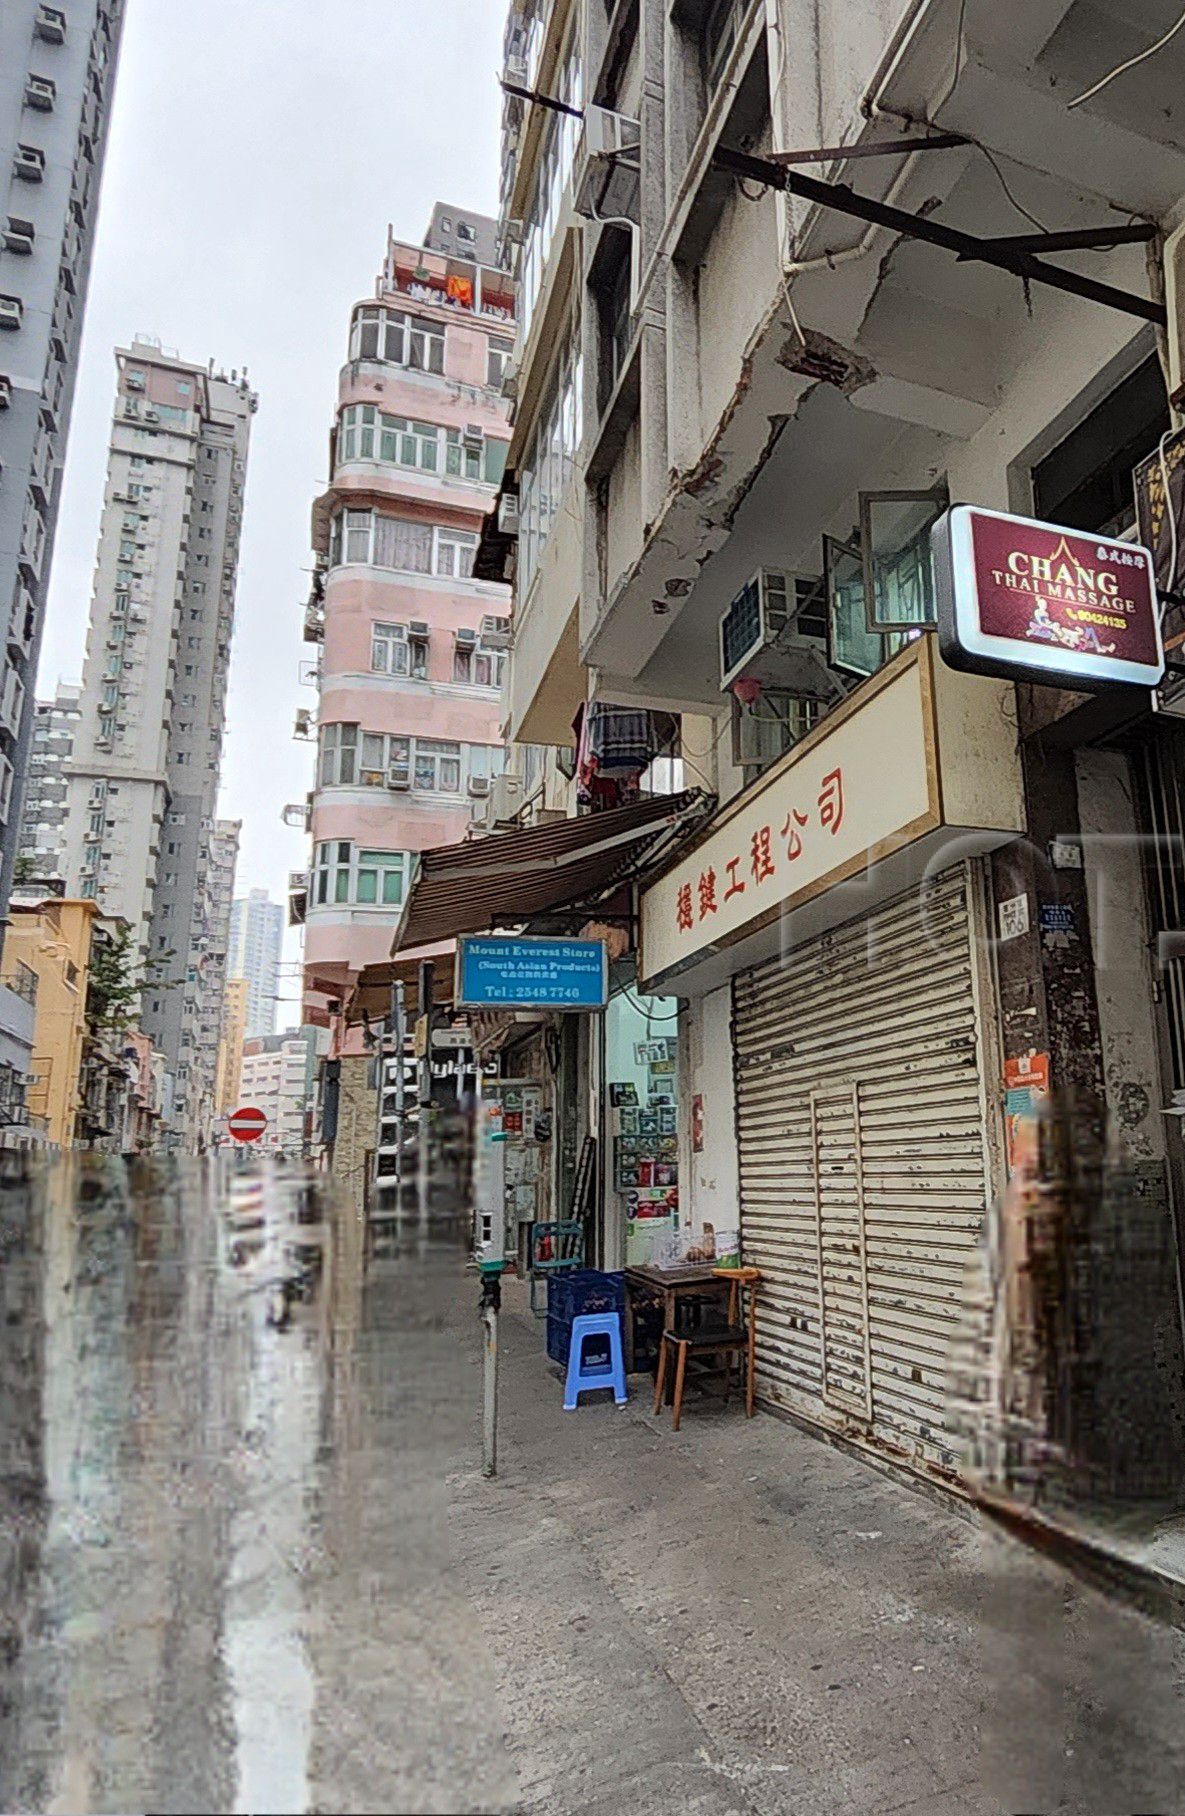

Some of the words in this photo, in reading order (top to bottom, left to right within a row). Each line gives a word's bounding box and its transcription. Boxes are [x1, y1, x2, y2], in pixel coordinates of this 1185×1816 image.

[1007, 551, 1119, 596] CHANG
[992, 570, 1039, 593] THAI
[1047, 582, 1136, 613] MASSAGE
[469, 945, 509, 956] Mount
[513, 946, 560, 956] Everest
[562, 947, 595, 958] Store
[517, 962, 547, 970] Asian
[516, 986, 547, 998] 2548
